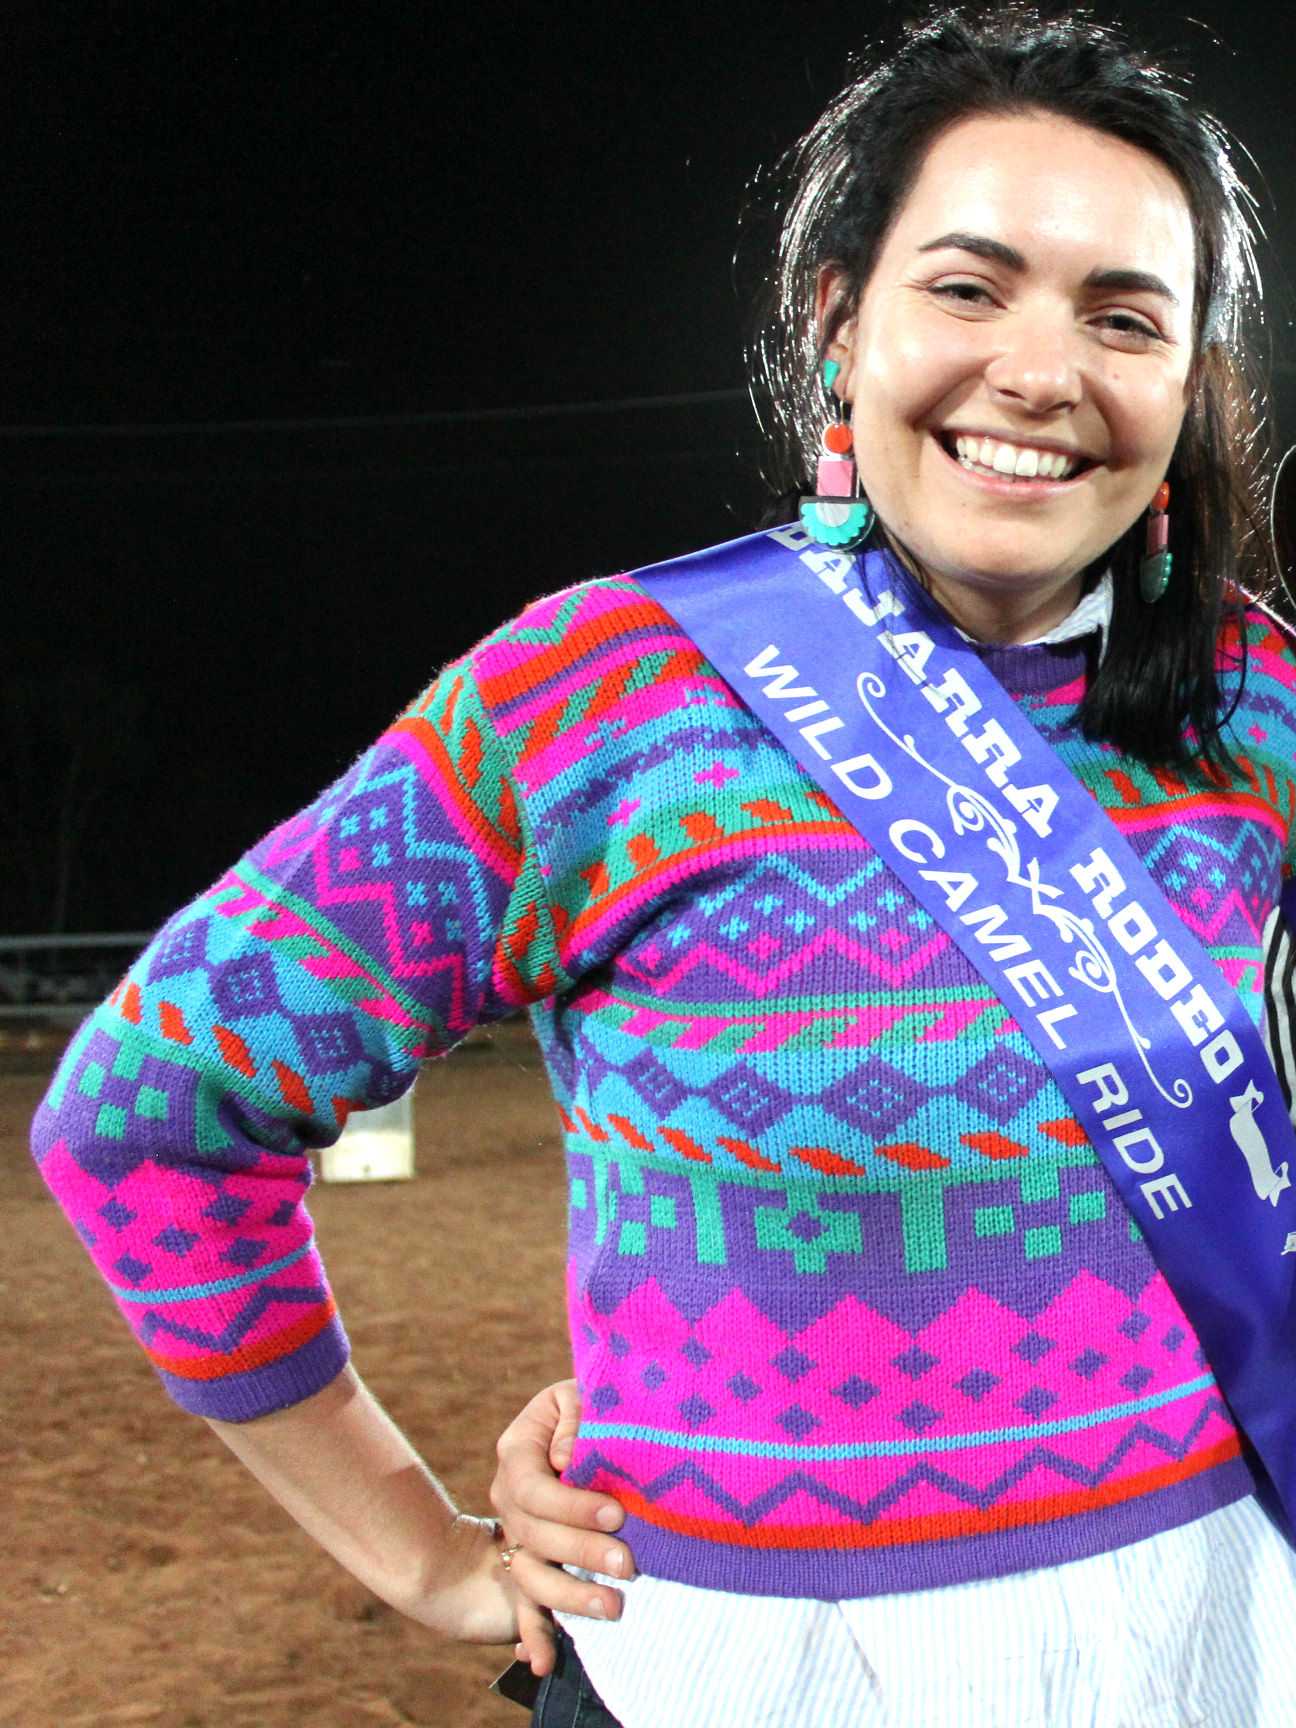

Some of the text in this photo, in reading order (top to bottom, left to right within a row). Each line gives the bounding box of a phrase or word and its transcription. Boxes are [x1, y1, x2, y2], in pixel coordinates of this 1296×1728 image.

[744, 645, 1192, 1220] WILD CAMEL RIDE
[1070, 849, 1245, 1083] RODEO
